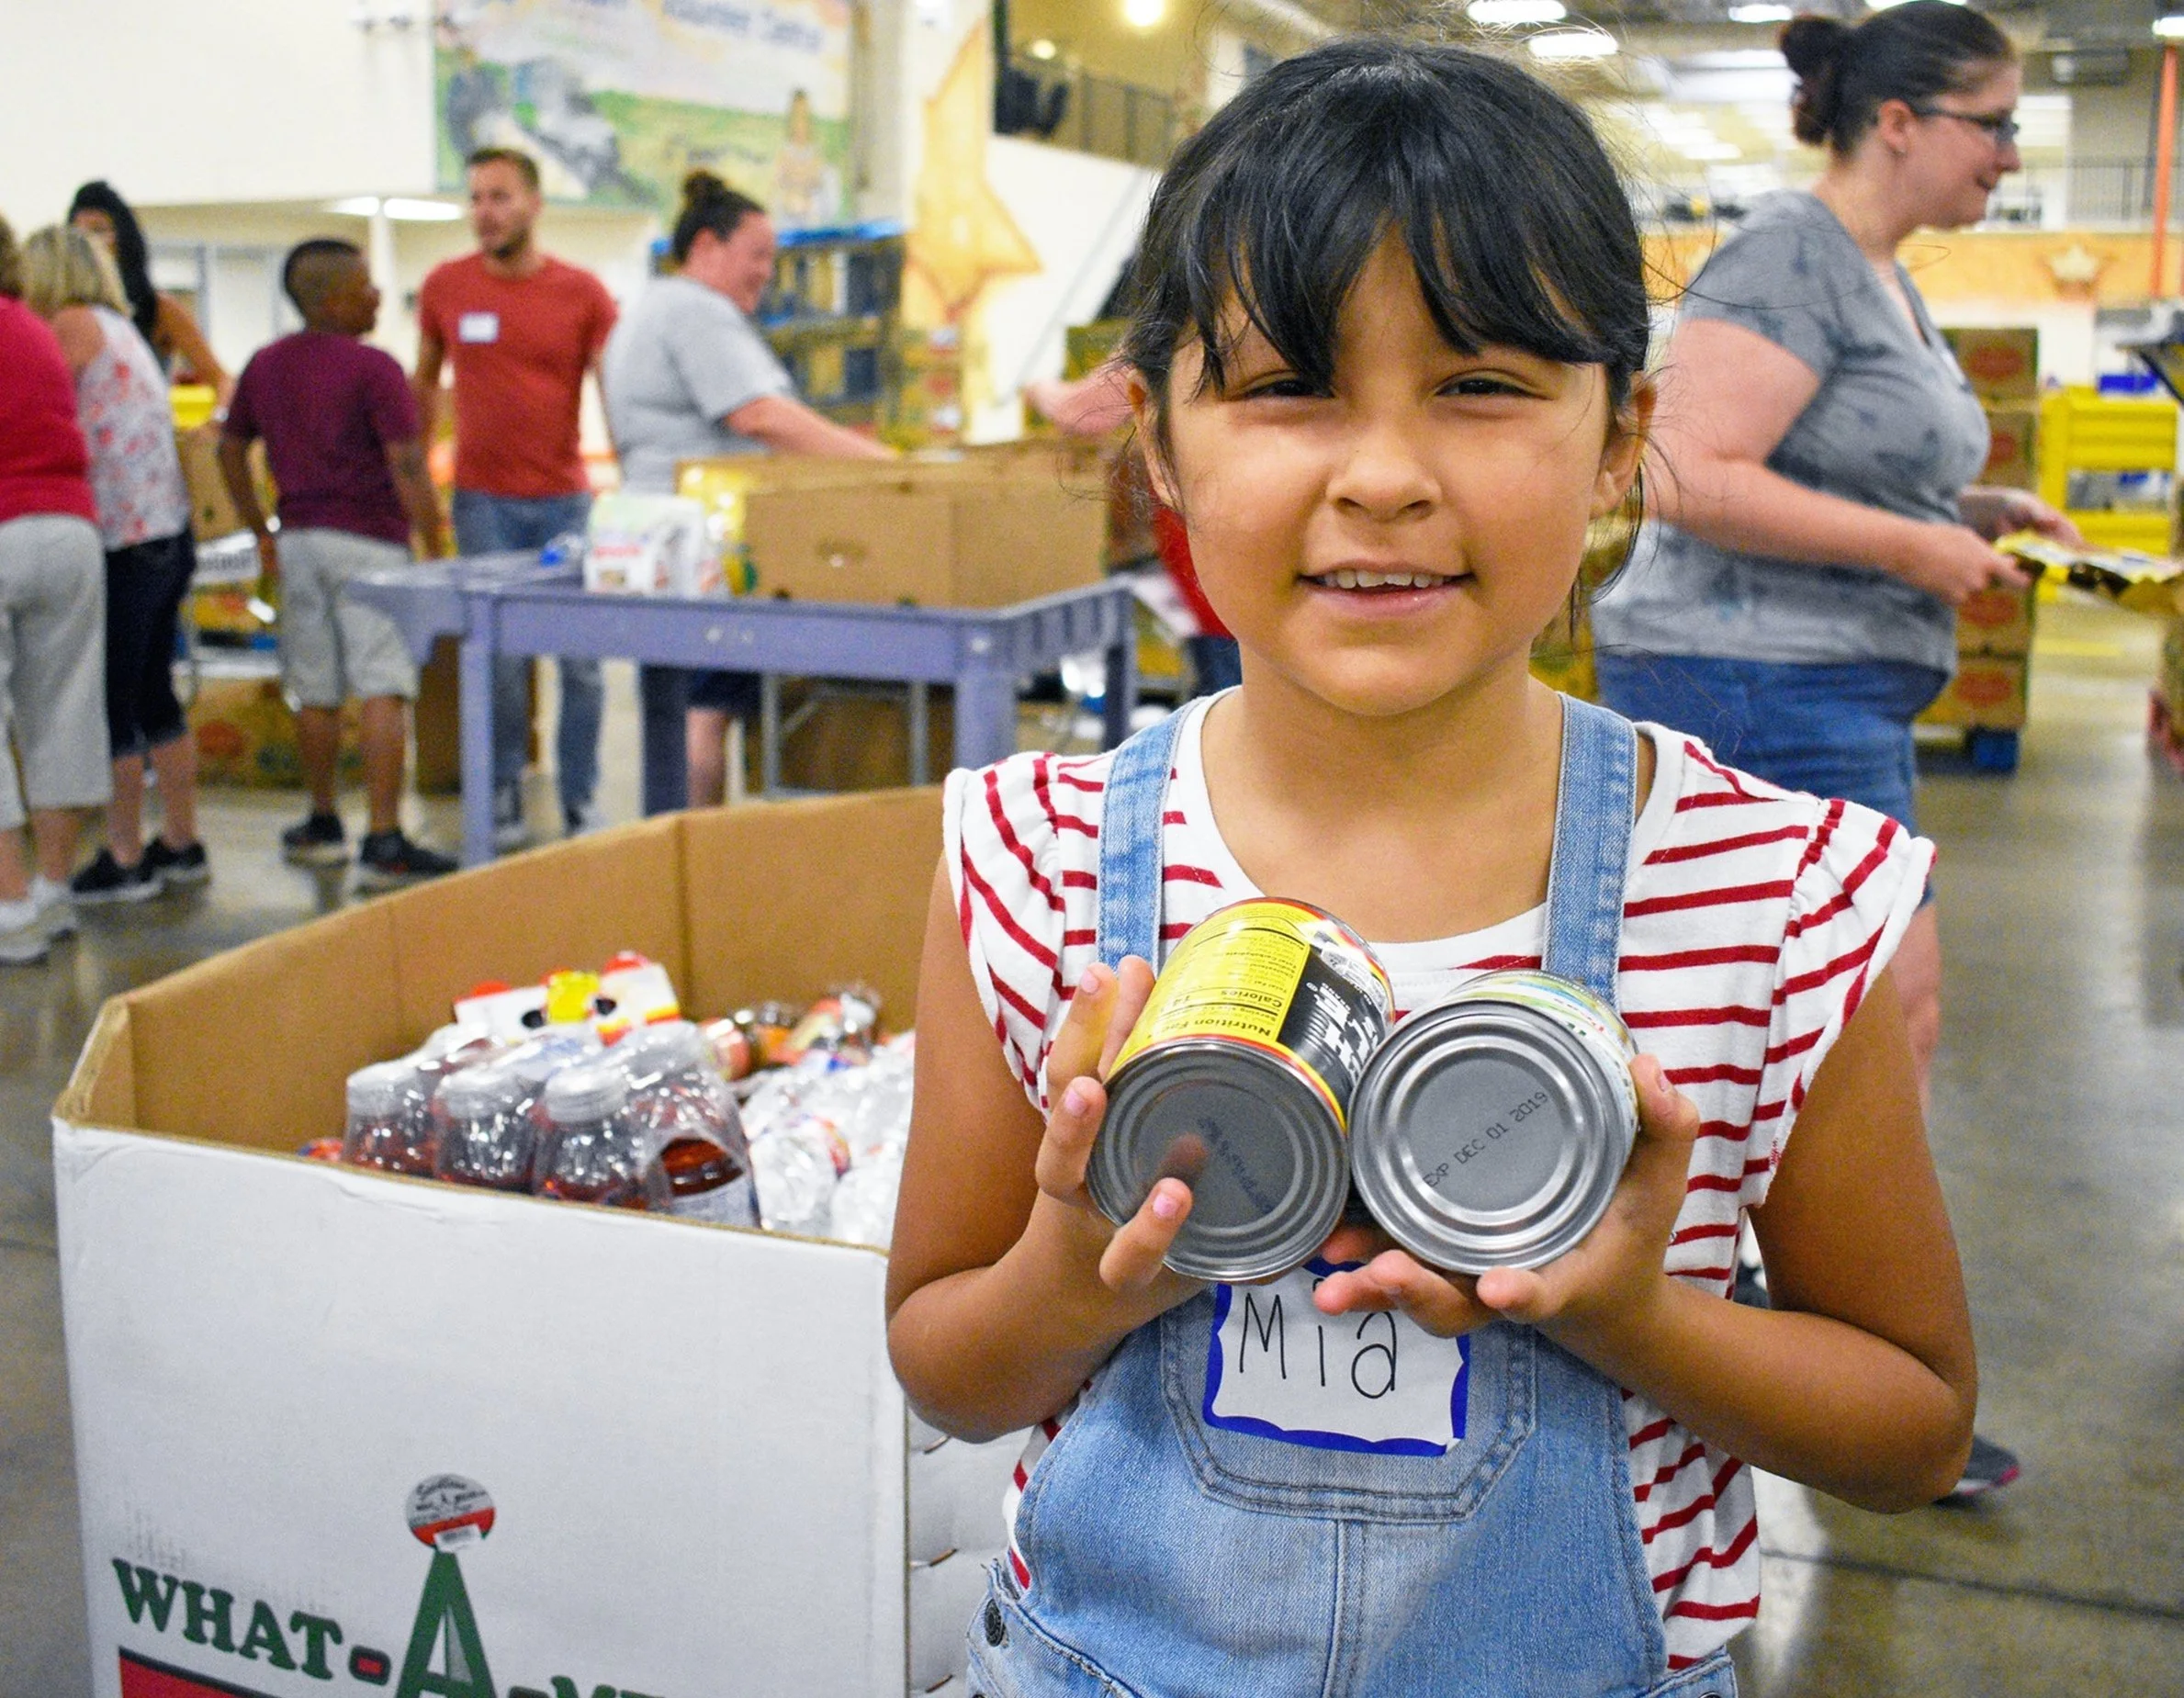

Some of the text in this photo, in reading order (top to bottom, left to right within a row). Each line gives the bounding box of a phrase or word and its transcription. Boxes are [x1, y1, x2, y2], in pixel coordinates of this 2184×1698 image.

[1194, 1018, 1272, 1037] Nutrition
[1221, 990, 1283, 1008] Calories
[1423, 1091, 1548, 1187] EXP DEC 01 2019
[1239, 1279, 1397, 1400] Mia
